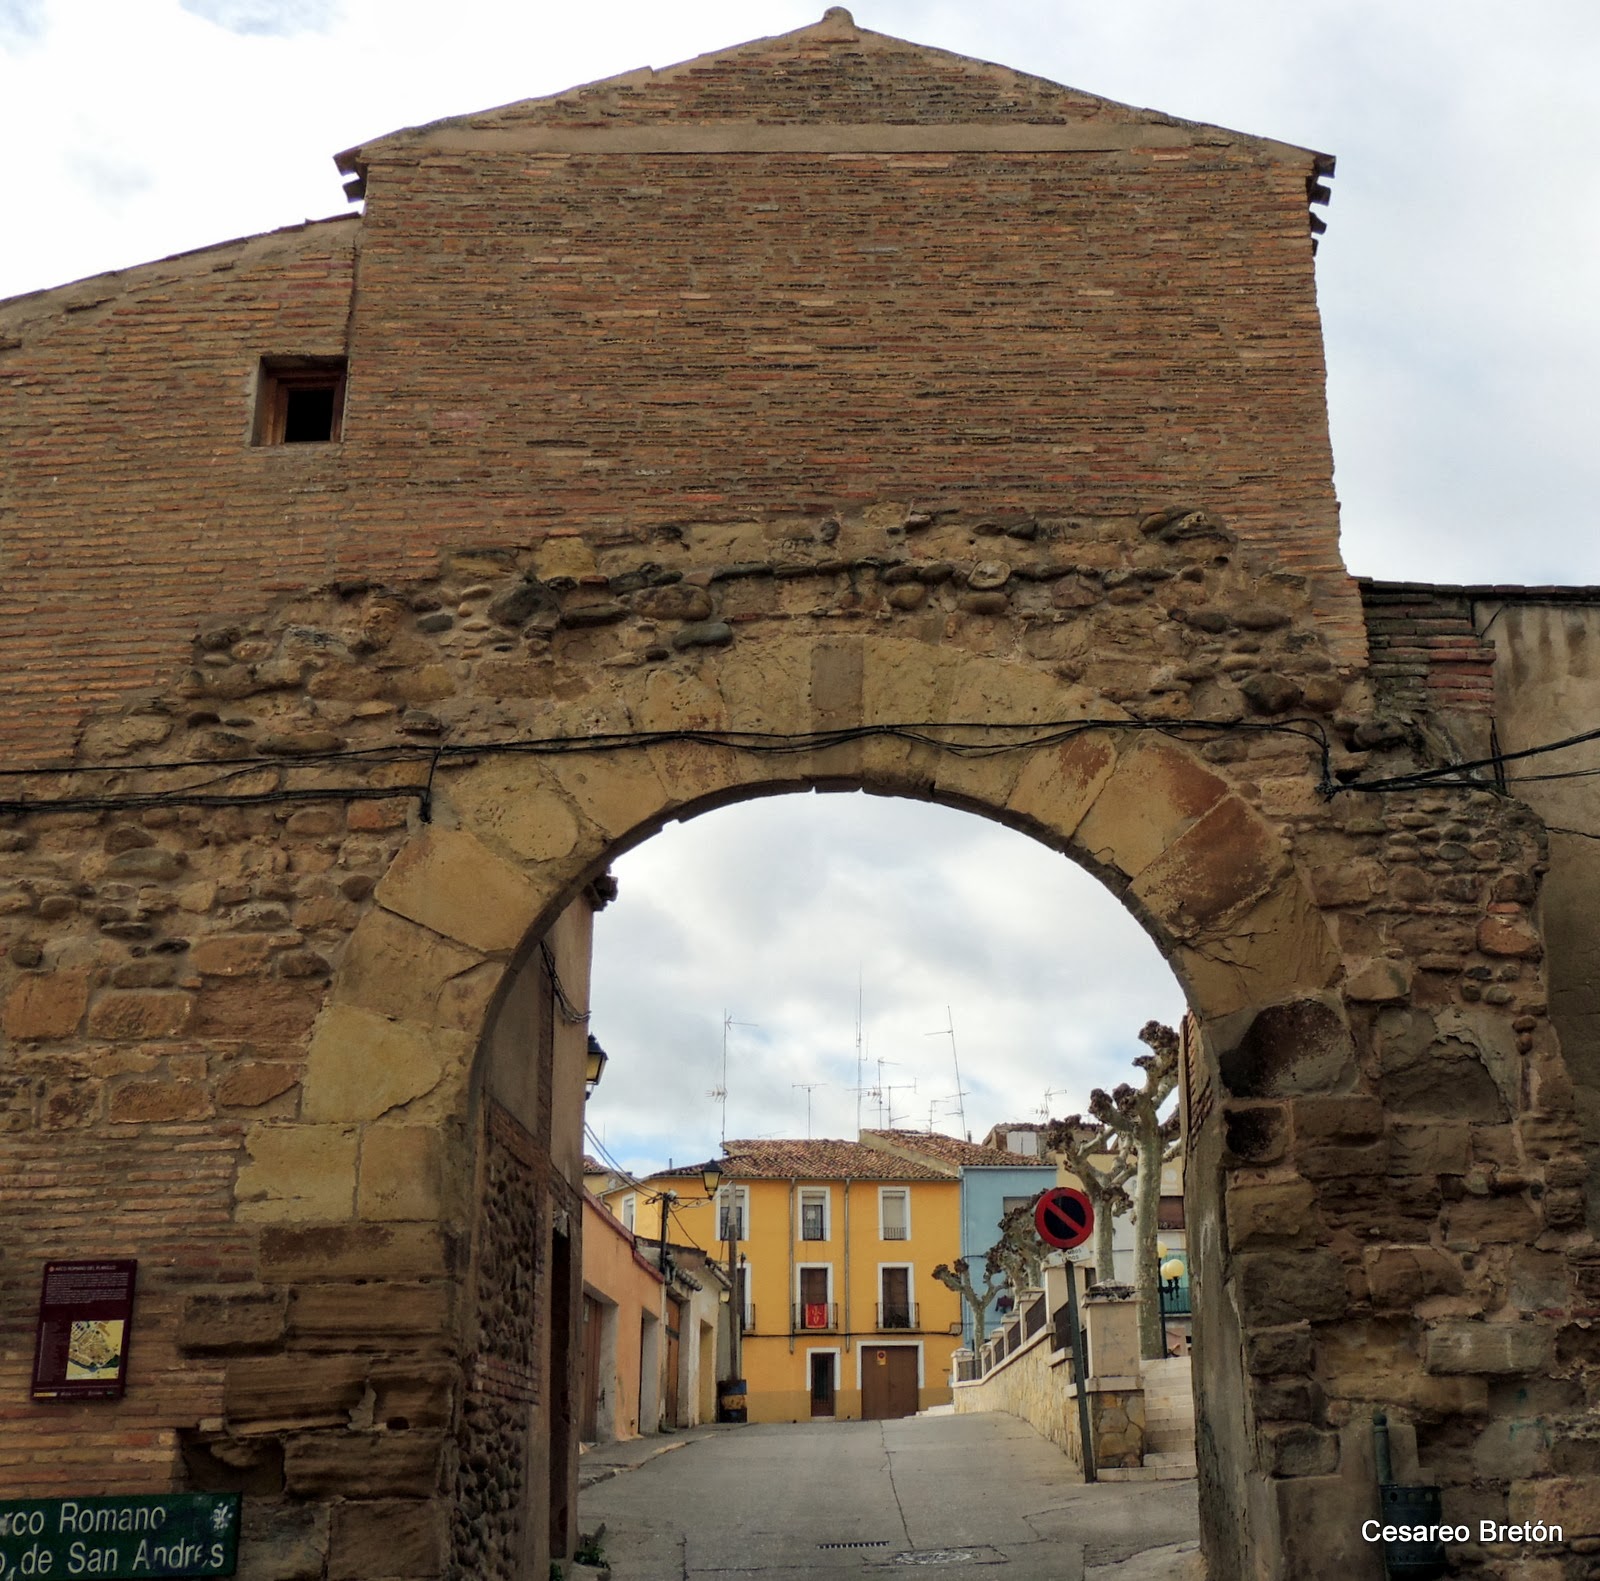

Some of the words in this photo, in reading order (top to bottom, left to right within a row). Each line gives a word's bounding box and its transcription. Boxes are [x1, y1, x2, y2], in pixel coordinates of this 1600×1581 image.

[58, 1502, 166, 1533] Romano
[21, 1543, 53, 1574] de
[67, 1541, 118, 1574] San
